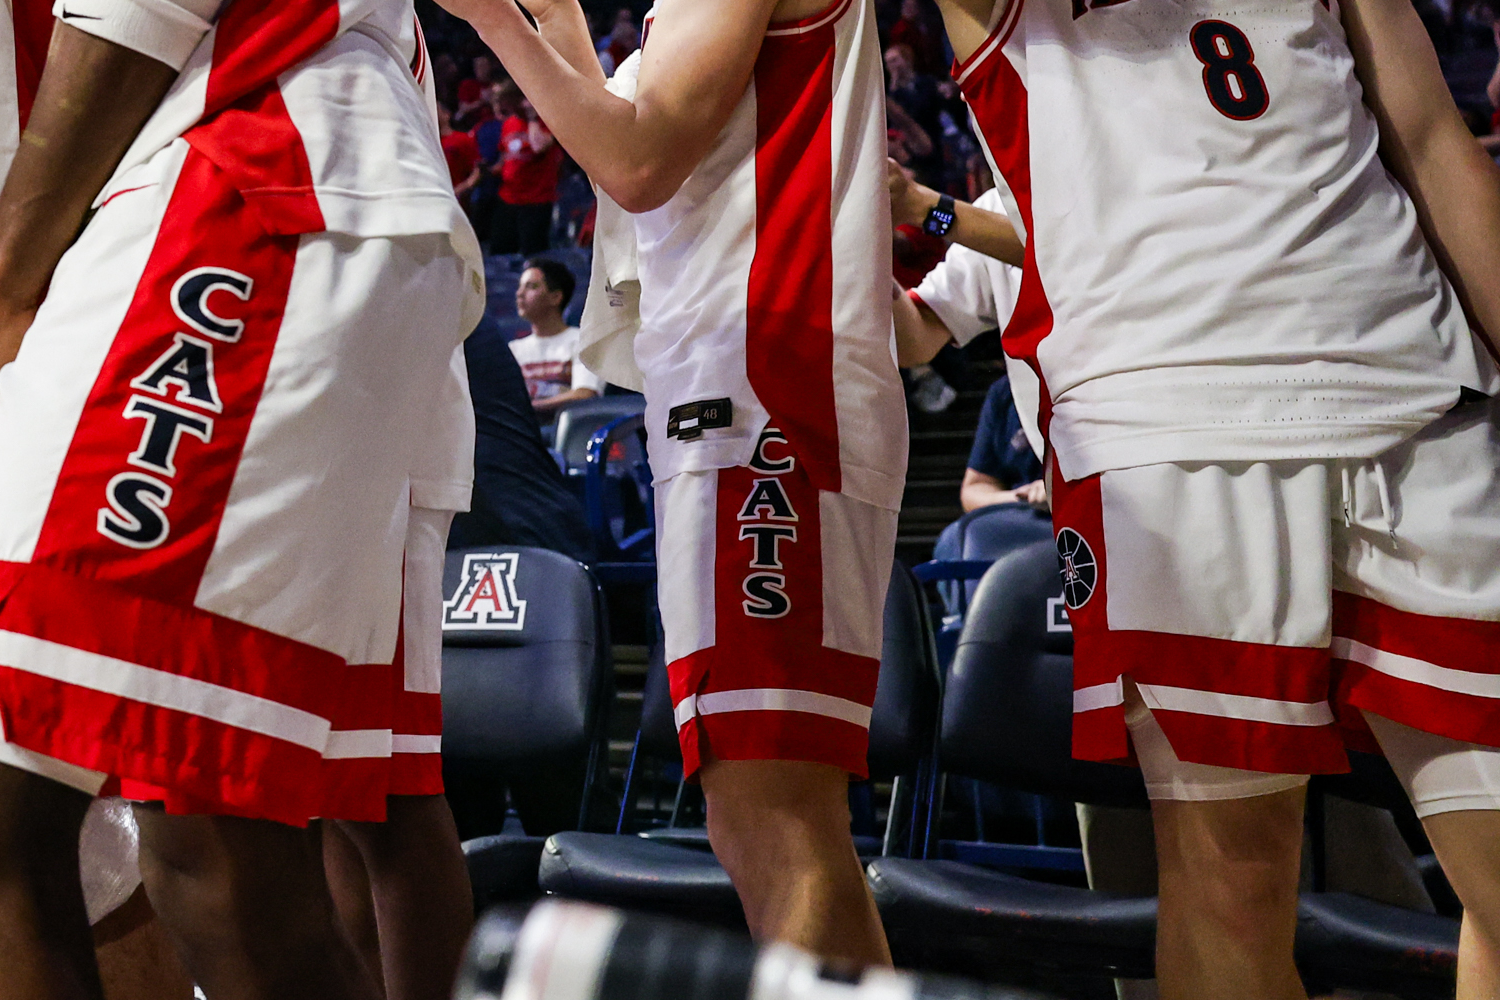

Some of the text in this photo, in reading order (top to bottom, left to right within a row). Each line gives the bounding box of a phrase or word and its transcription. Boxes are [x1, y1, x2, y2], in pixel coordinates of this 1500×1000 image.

[1188, 18, 1271, 121] 8
[96, 266, 255, 551] CATS
[703, 407, 719, 421] 48
[737, 428, 799, 620] CATS
